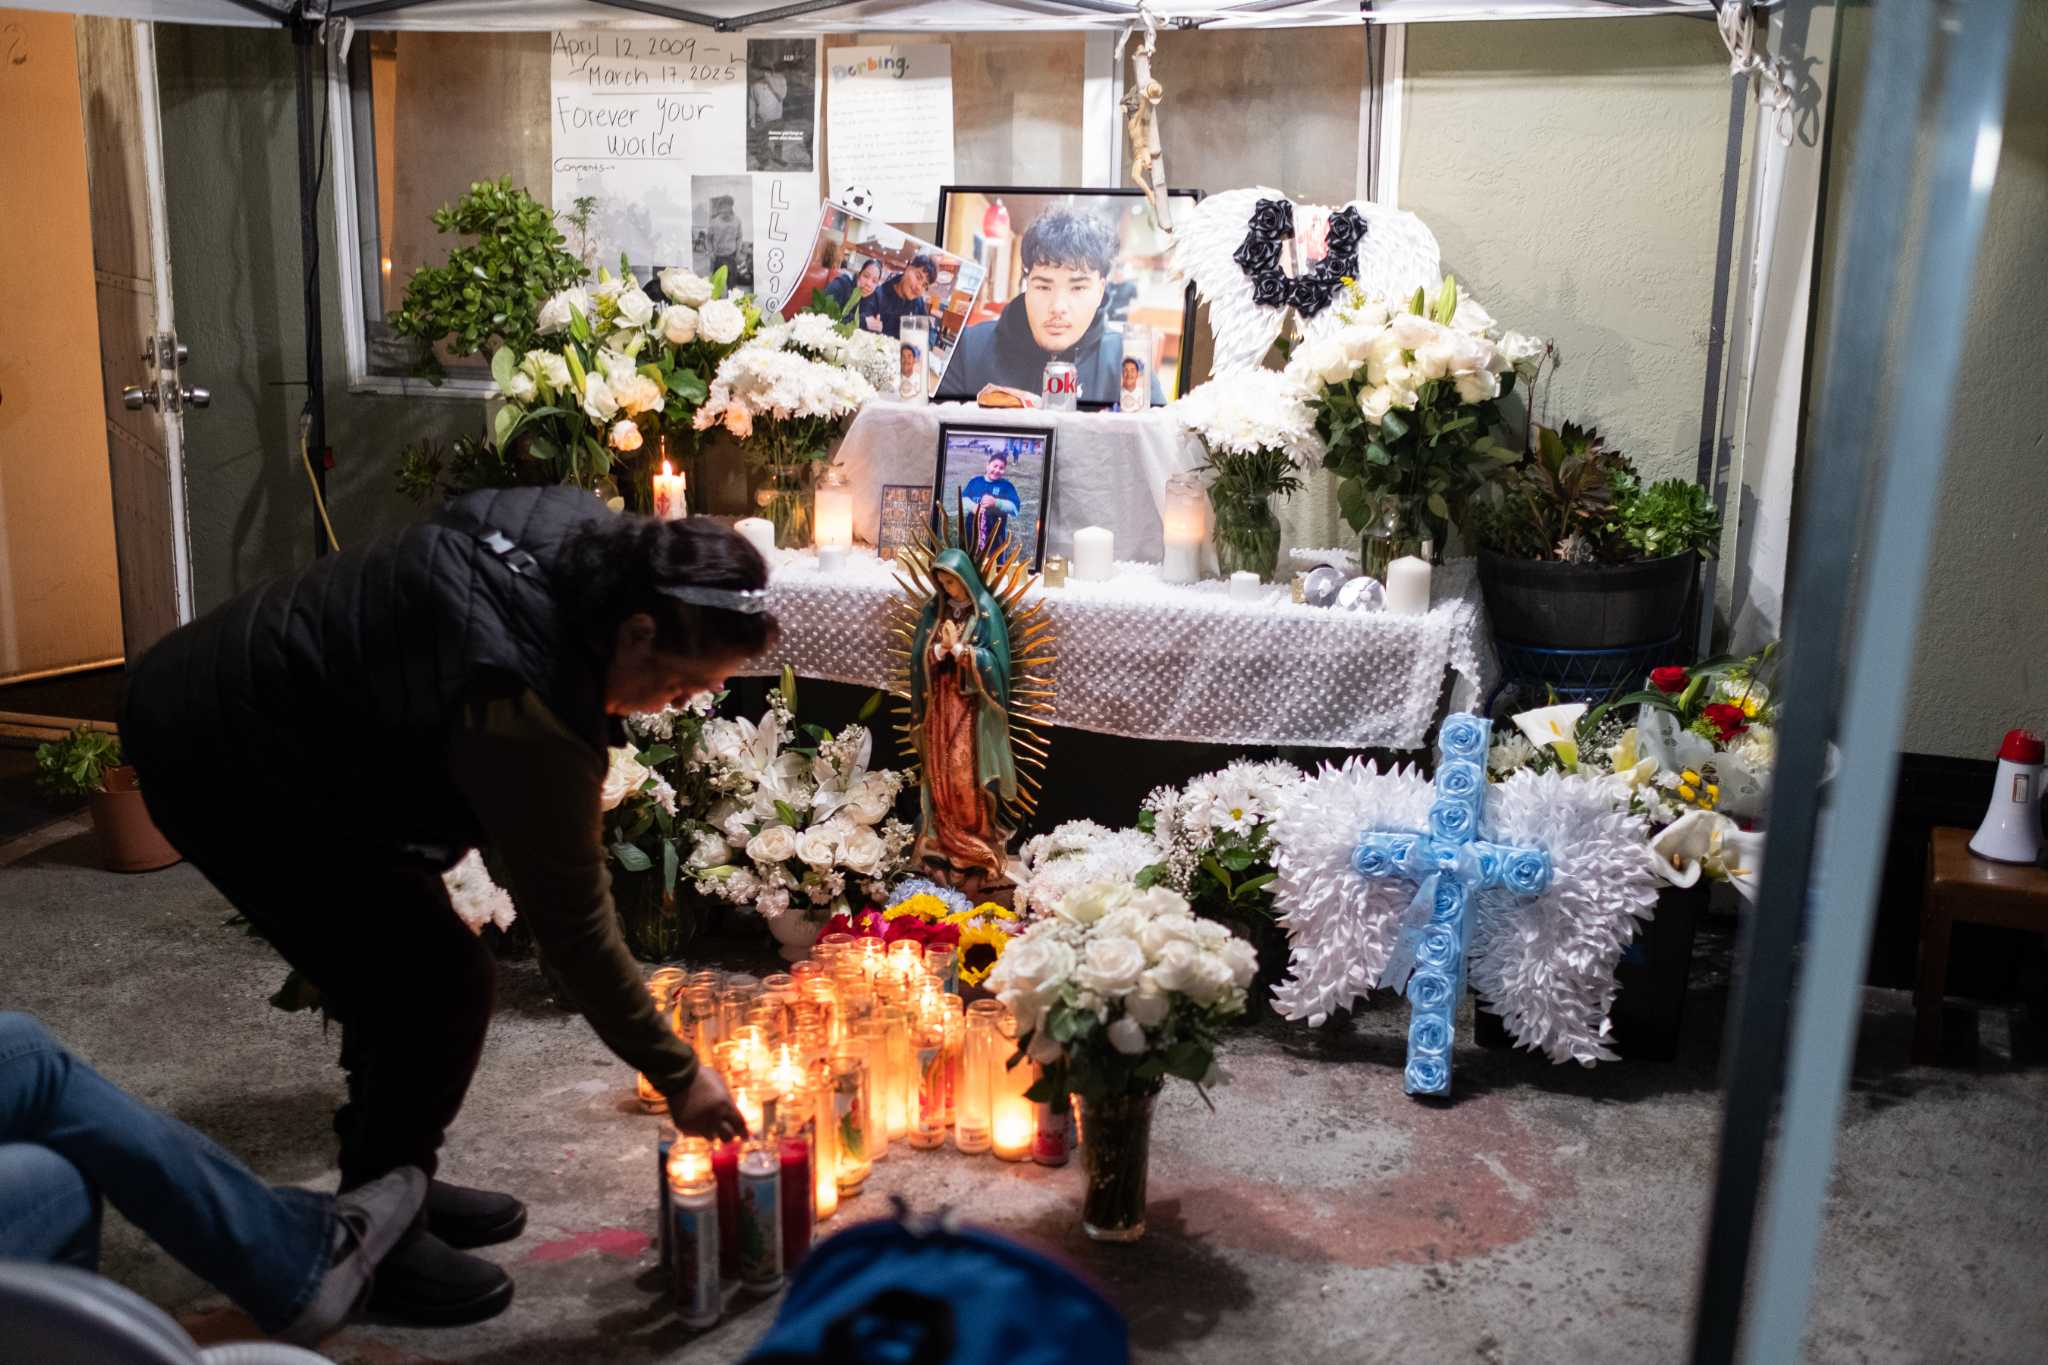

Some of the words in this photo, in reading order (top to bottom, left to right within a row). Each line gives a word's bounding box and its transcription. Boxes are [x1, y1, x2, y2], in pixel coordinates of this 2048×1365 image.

[552, 31, 600, 66] April
[615, 37, 639, 60] 12,
[648, 38, 696, 62] 2009
[589, 66, 649, 86] March
[689, 64, 736, 81] 2025
[556, 96, 640, 134] Forever
[1045, 371, 1078, 394] ok
